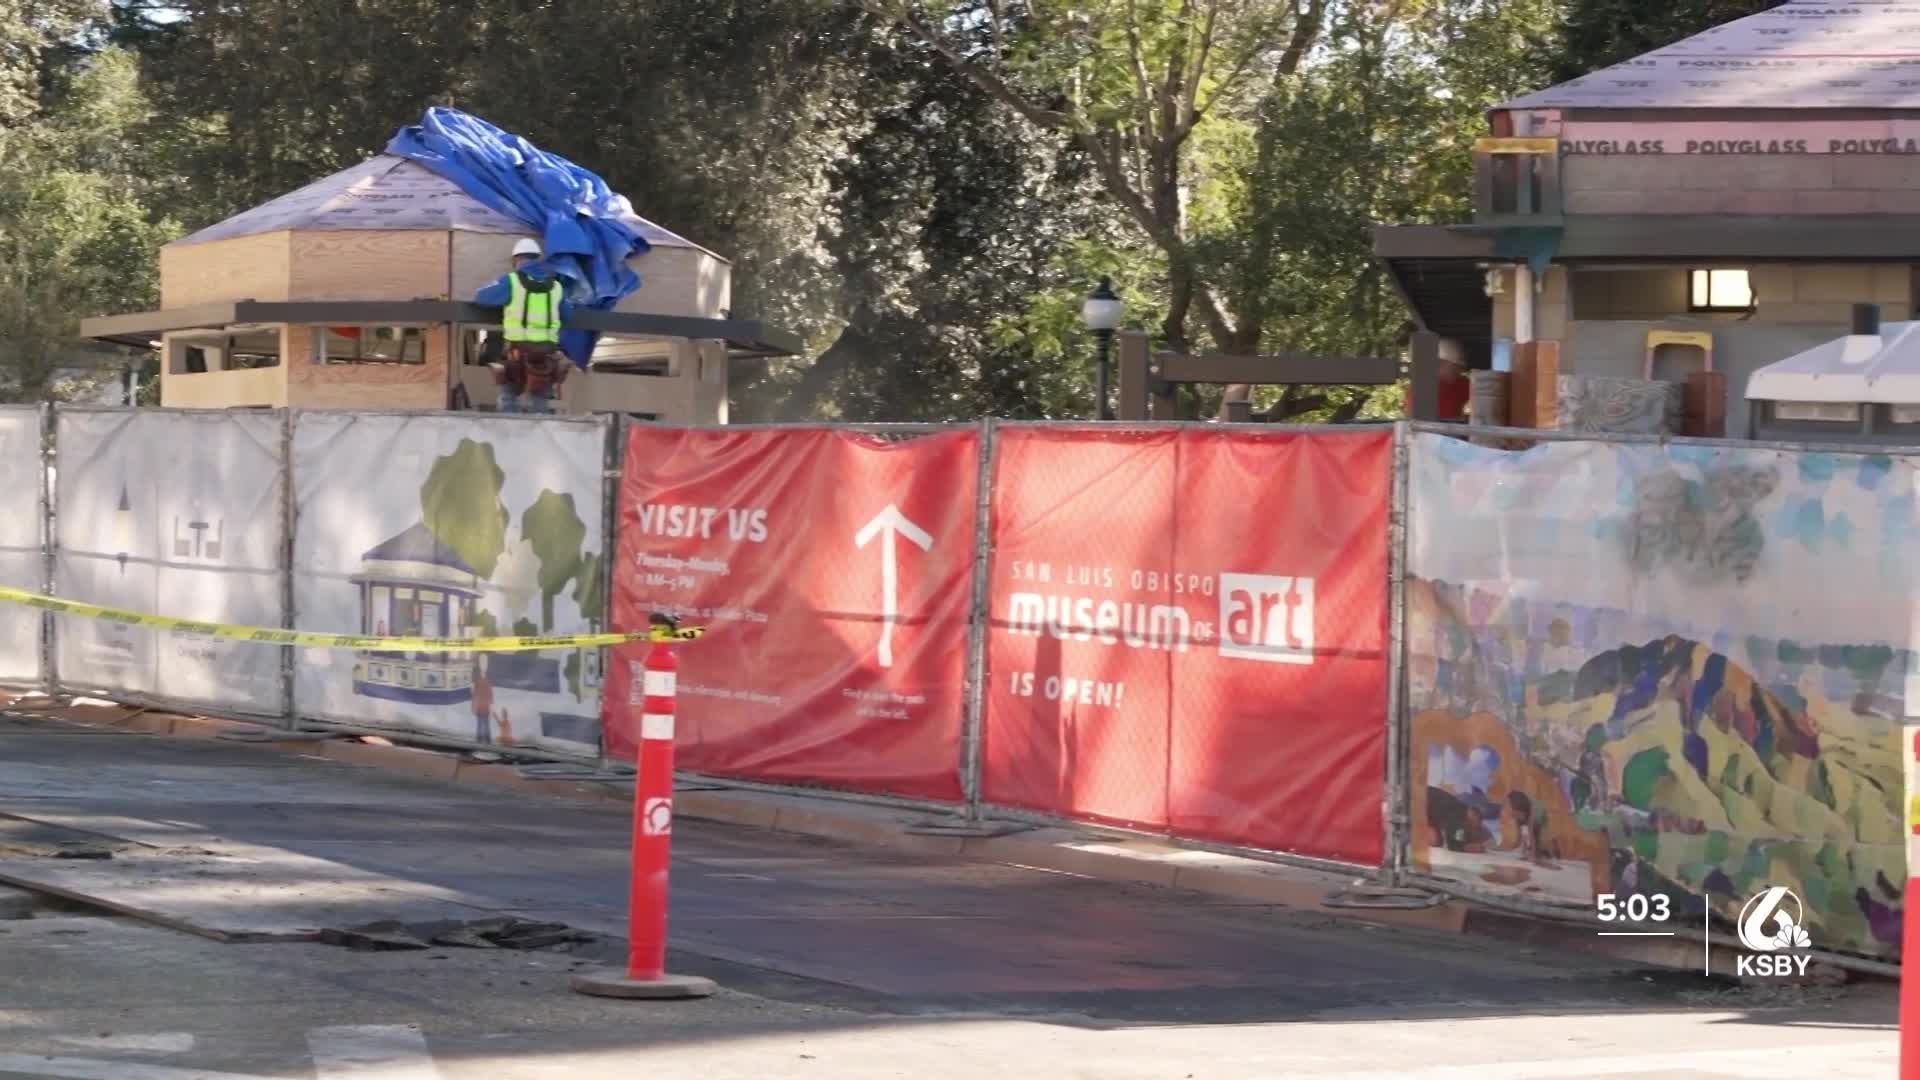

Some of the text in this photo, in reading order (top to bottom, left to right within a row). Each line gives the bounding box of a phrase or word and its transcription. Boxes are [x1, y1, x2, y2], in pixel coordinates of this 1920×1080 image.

[1686, 139, 1807, 154] POLYGLASS
[636, 503, 768, 542] VISIT US
[1011, 560, 1215, 596] SAN LUIS OBISPO
[1007, 576, 1308, 654] museum OF art
[1010, 671, 1125, 708] IS OPEN!
